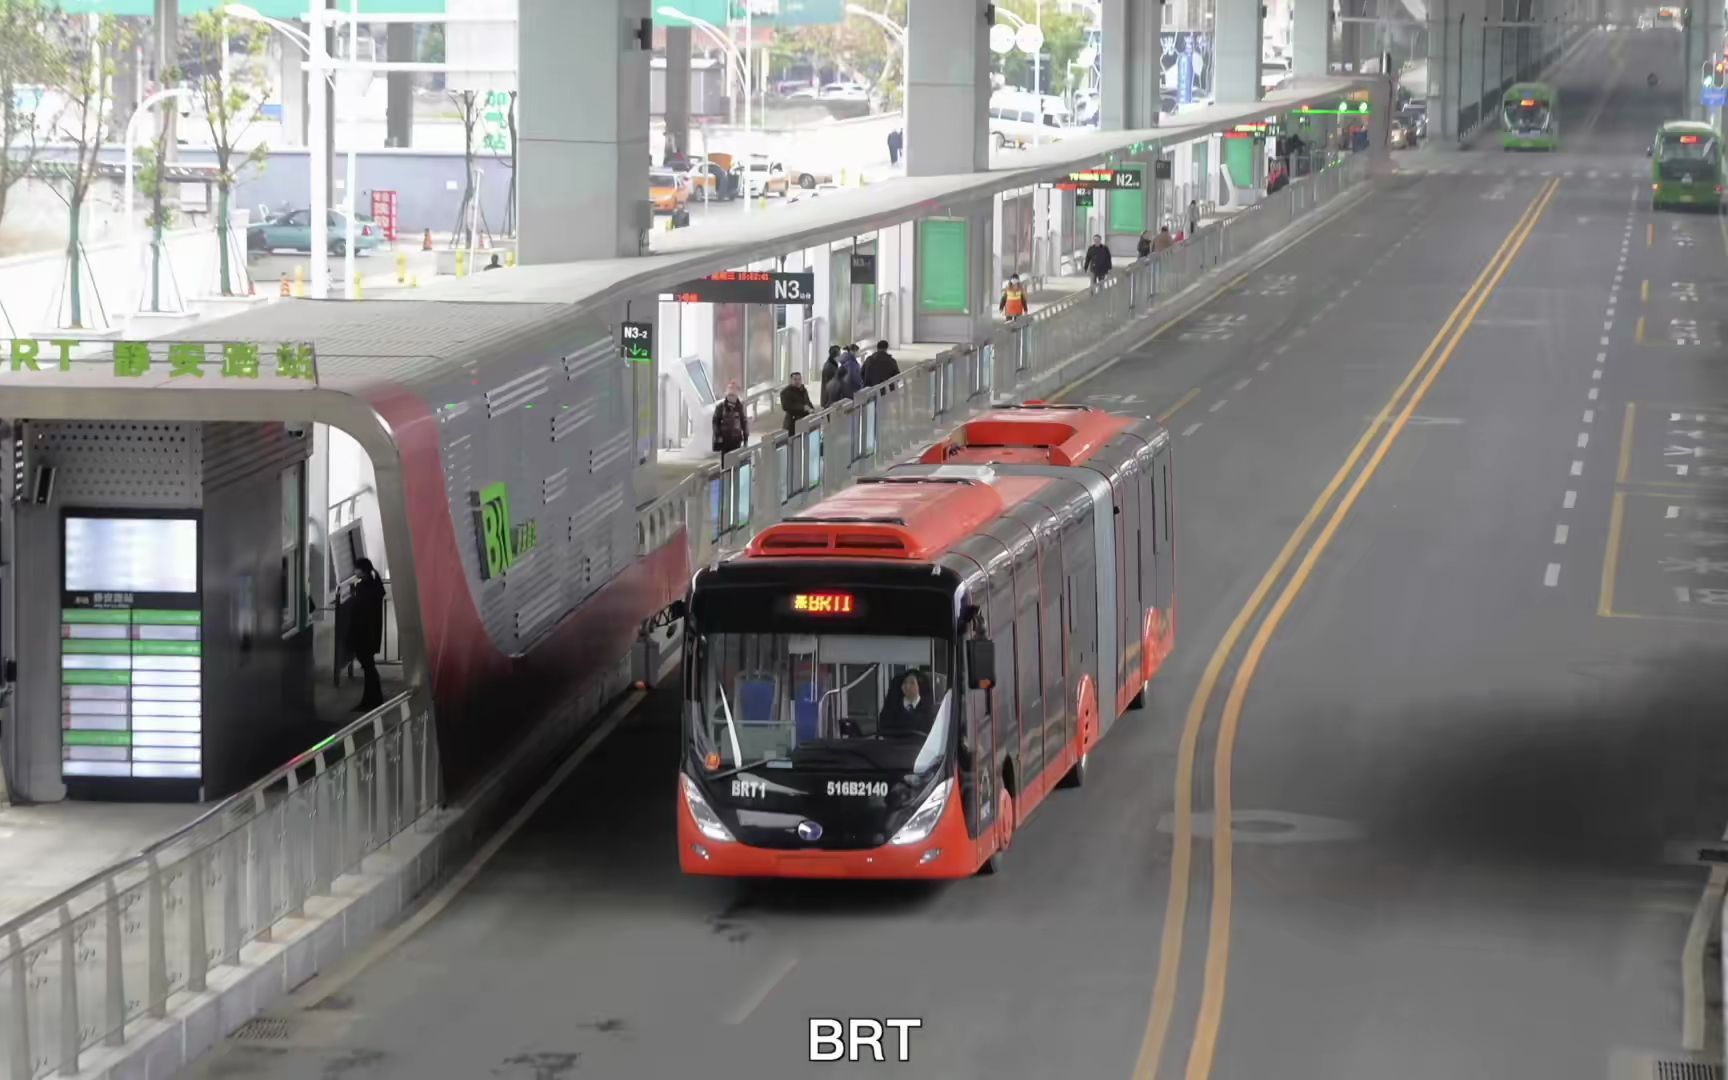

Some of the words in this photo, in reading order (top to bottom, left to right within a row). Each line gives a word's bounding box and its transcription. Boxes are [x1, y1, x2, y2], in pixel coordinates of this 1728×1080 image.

[1116, 173, 1133, 187] N2
[775, 280, 800, 299] N3
[624, 326, 648, 339] N3-2
[0, 338, 80, 371] RT
[731, 780, 766, 798] BRT1
[826, 780, 889, 797] 516B2140
